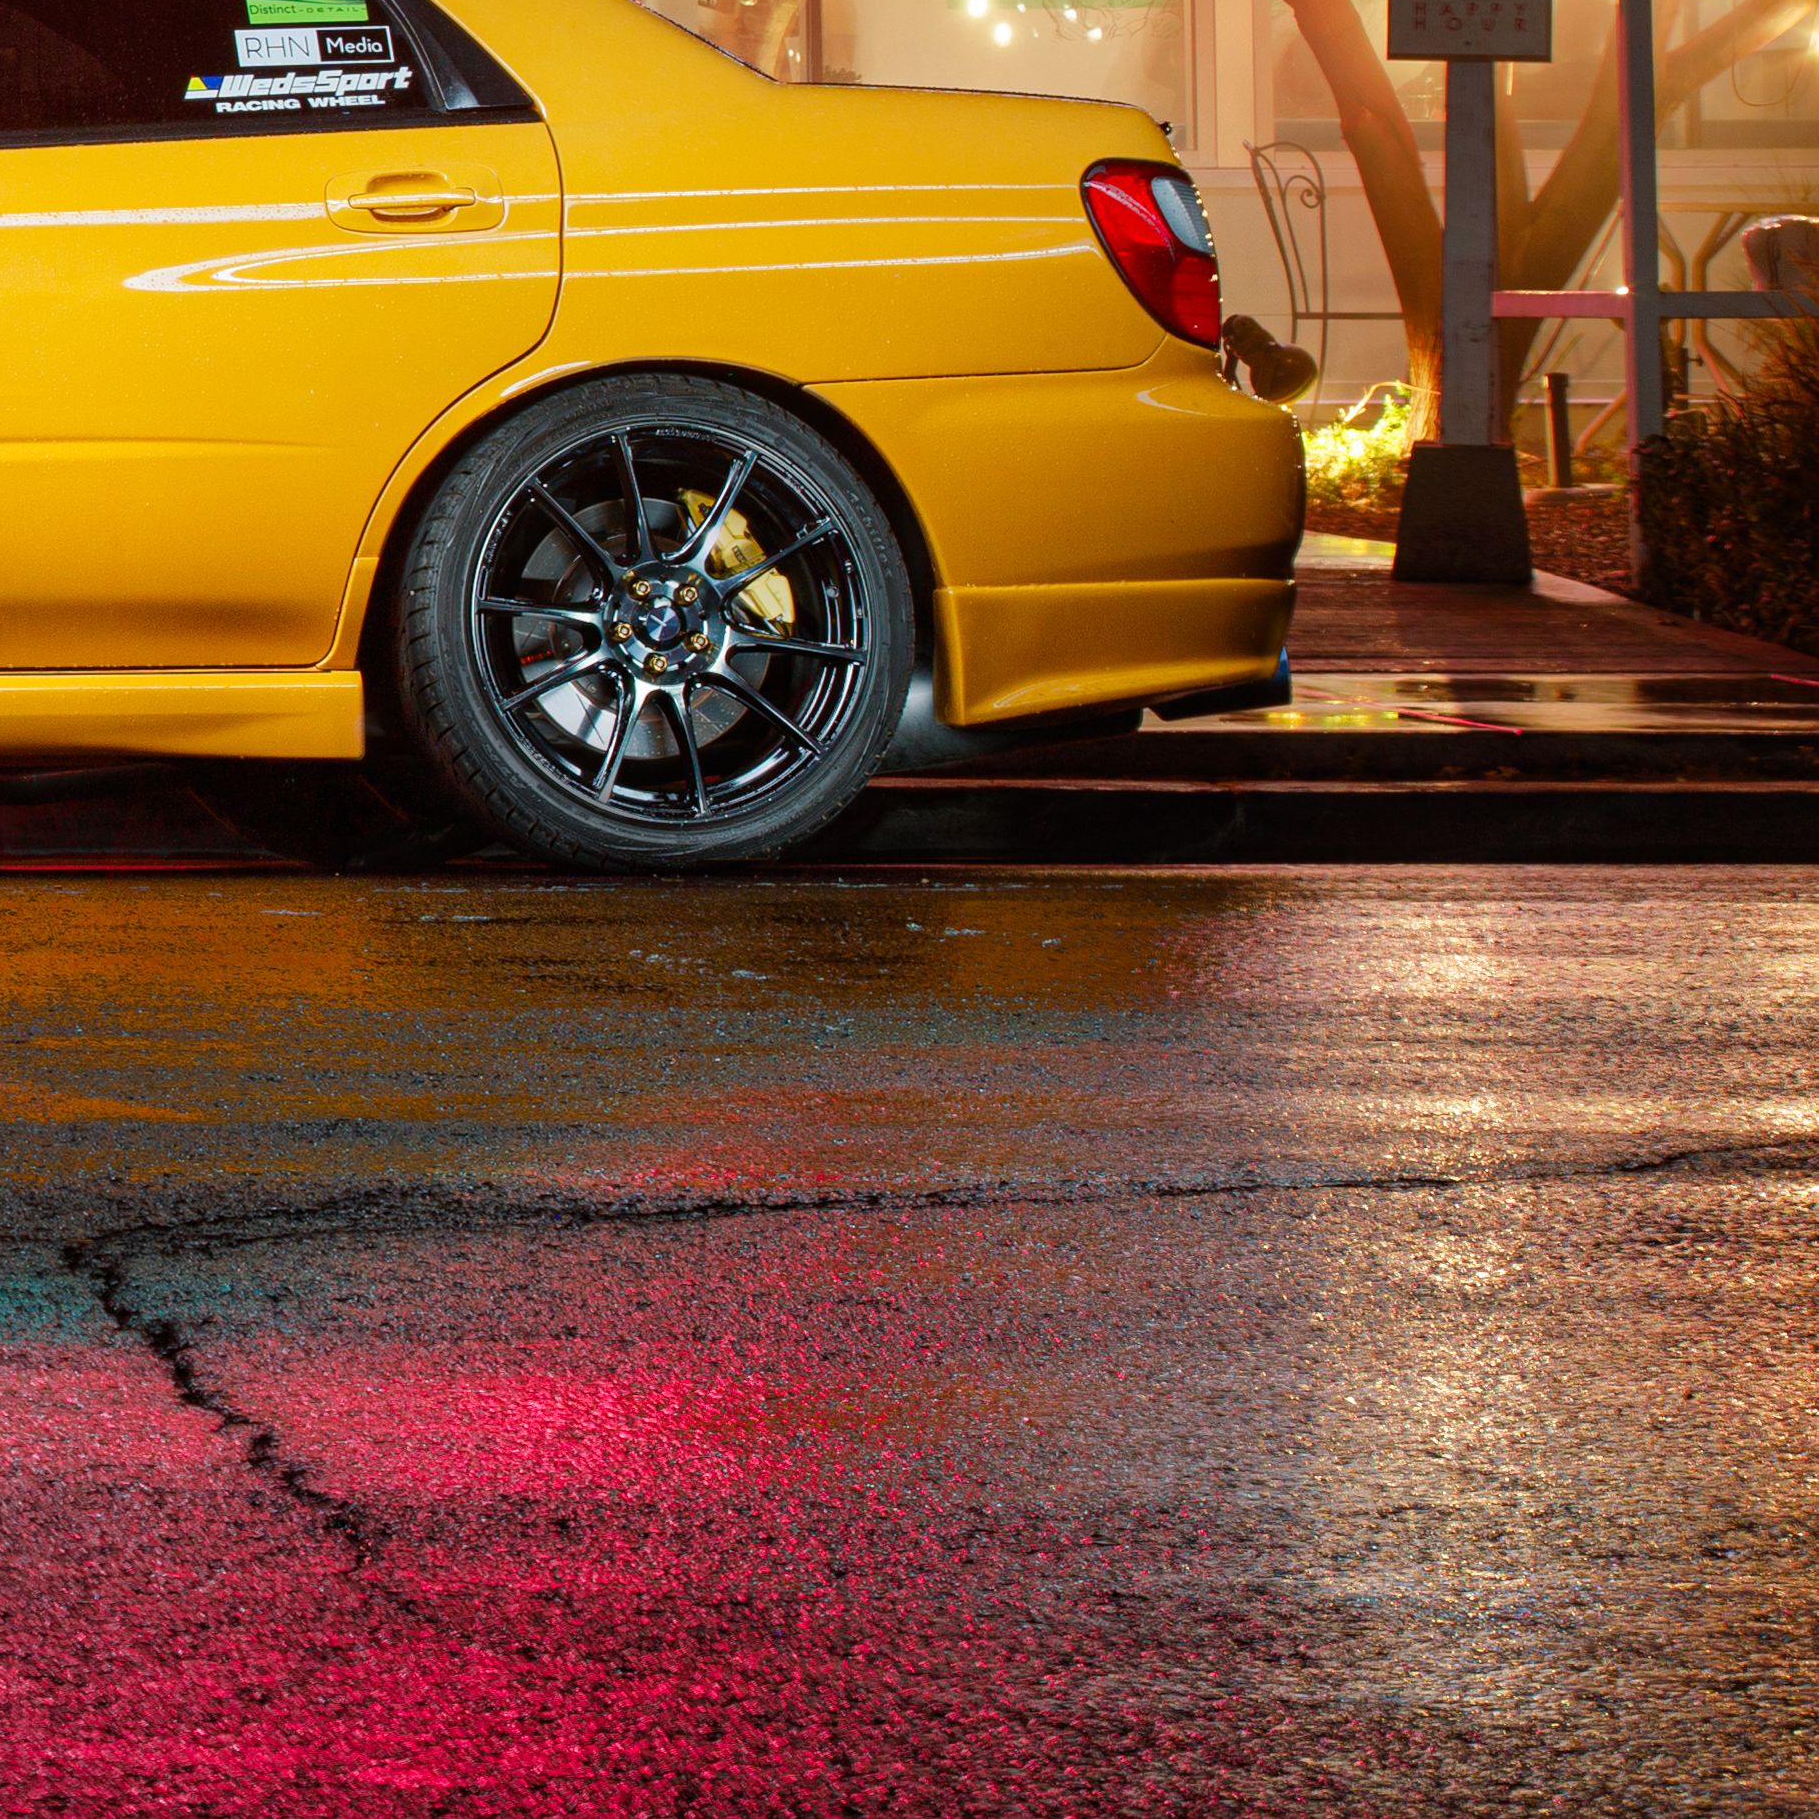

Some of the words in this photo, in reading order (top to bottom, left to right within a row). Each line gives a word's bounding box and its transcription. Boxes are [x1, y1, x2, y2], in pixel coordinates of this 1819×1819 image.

[249, 4, 296, 15] Distinct
[1414, 2, 1528, 16] HAPPY
[1414, 17, 1527, 31] HOUR
[244, 36, 310, 59] RHN
[325, 36, 383, 54] Media
[218, 66, 413, 98] WedsSport
[215, 98, 302, 113] RACING
[307, 94, 386, 109] WHEEL
